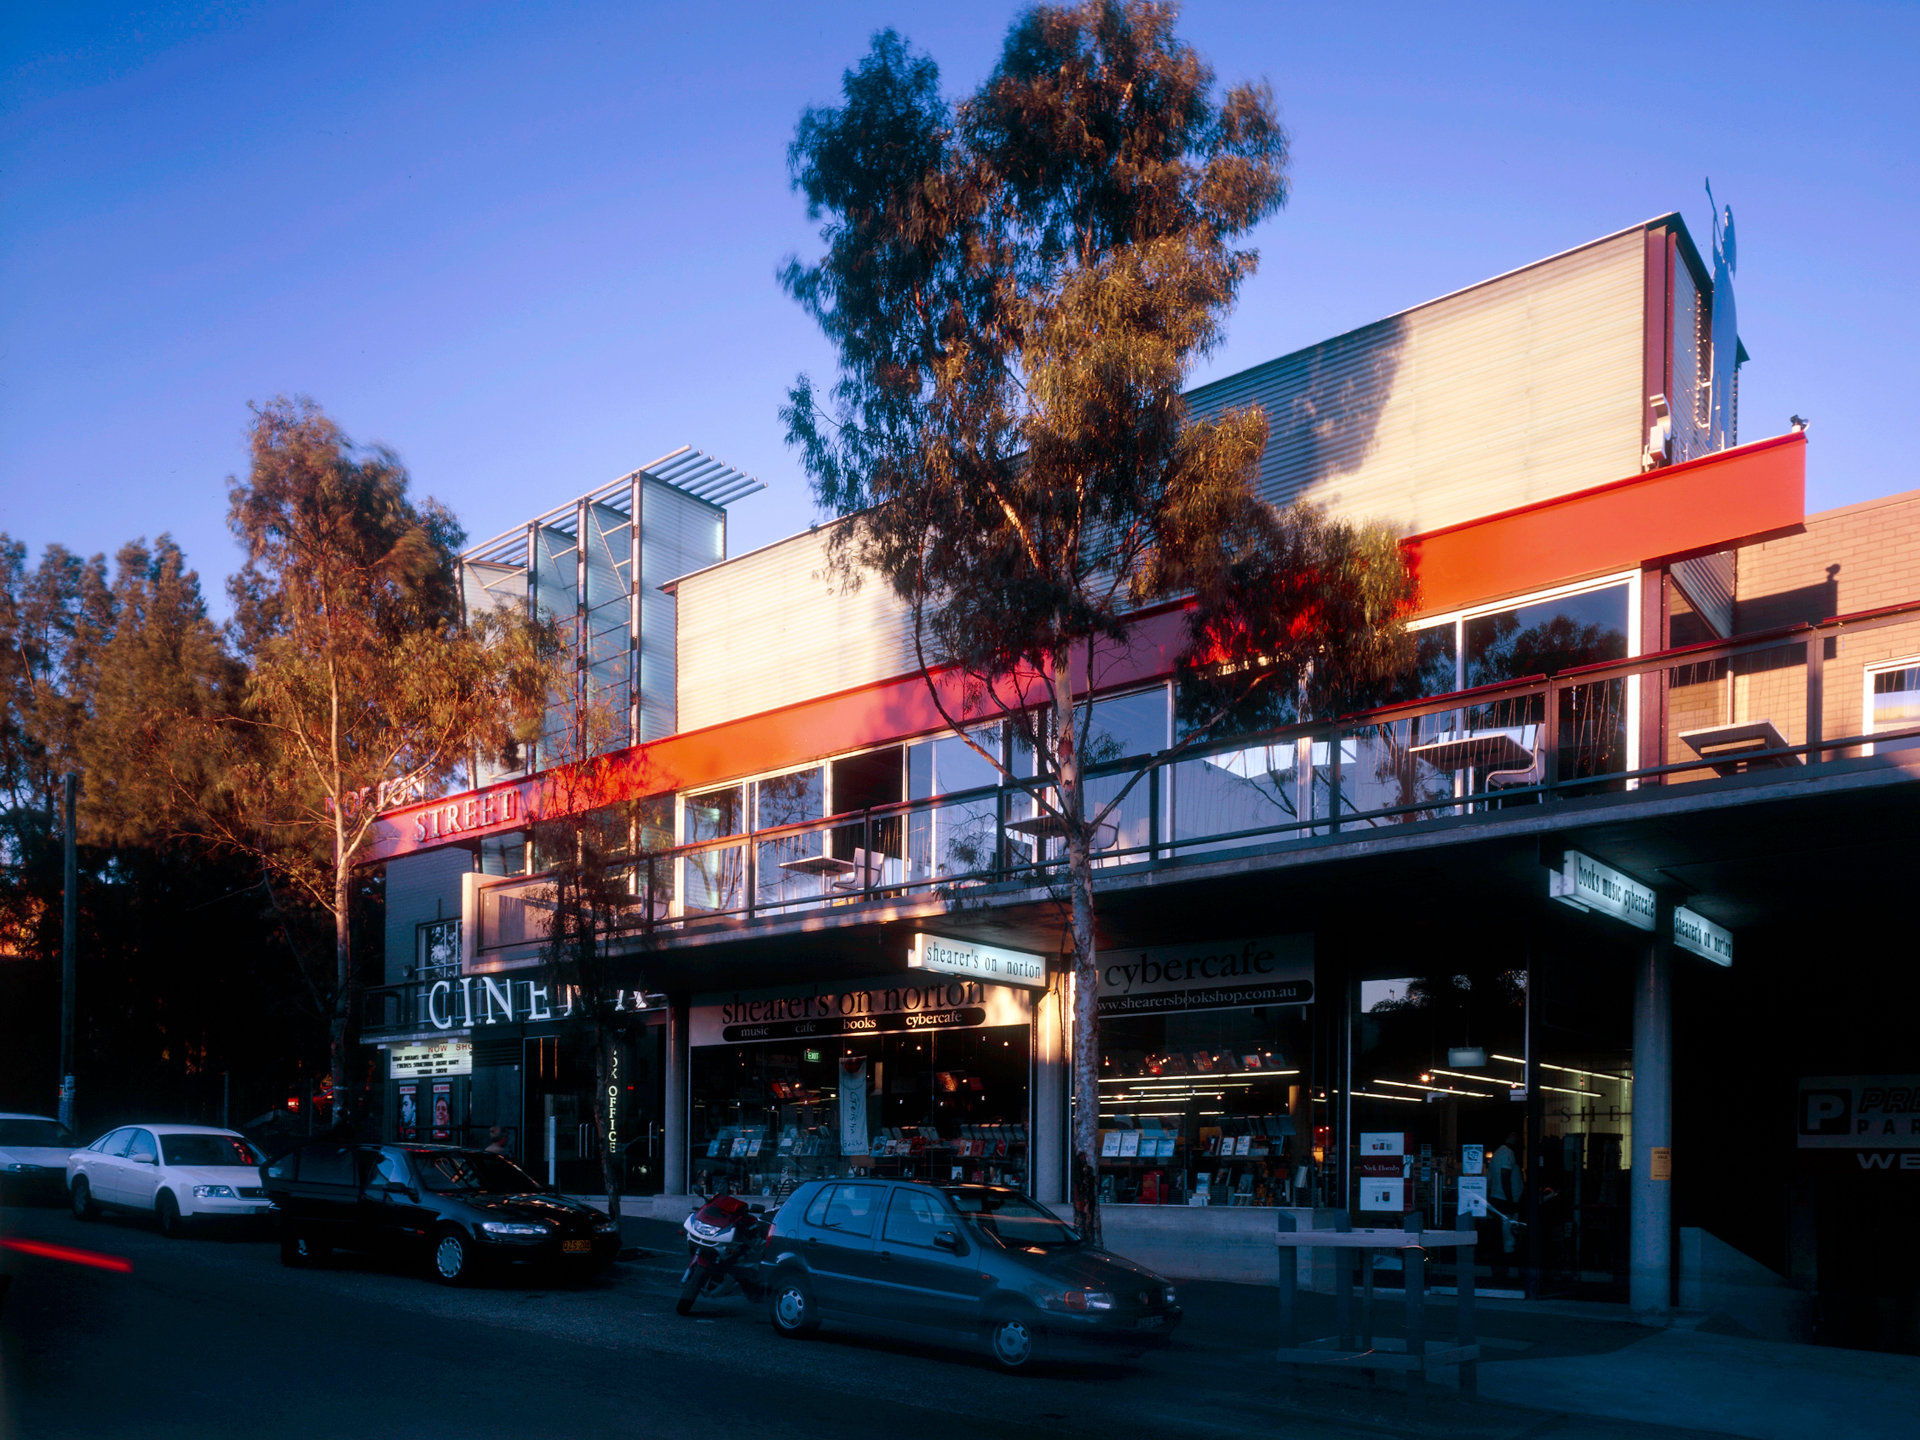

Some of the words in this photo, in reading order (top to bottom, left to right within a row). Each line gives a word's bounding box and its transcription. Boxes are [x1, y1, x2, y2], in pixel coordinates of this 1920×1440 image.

[415, 788, 518, 842] STREET
[1578, 857, 1600, 893] books
[1602, 875, 1621, 903] music
[1624, 884, 1654, 918] cybercafe
[1674, 911, 1702, 944] shearer's
[1704, 930, 1711, 948] on
[1714, 935, 1731, 959] norton
[927, 941, 979, 969] shearer's
[985, 957, 997, 972] on
[1007, 960, 1041, 979] norton
[1105, 941, 1275, 994] cybercafe
[722, 985, 830, 1025] shearer's
[839, 989, 874, 1017] on
[884, 981, 986, 1012] norton
[1097, 987, 1298, 1011] ww.shearersbookshop.com.au
[741, 1025, 769, 1038] music
[795, 1022, 817, 1034] cafe
[843, 1017, 877, 1030] books
[905, 1011, 962, 1027] cybercafe
[428, 1045, 447, 1053] NOW
[808, 1052, 819, 1060] EXIT
[608, 1085, 618, 1153] OFFICE
[1807, 1094, 1846, 1131] P
